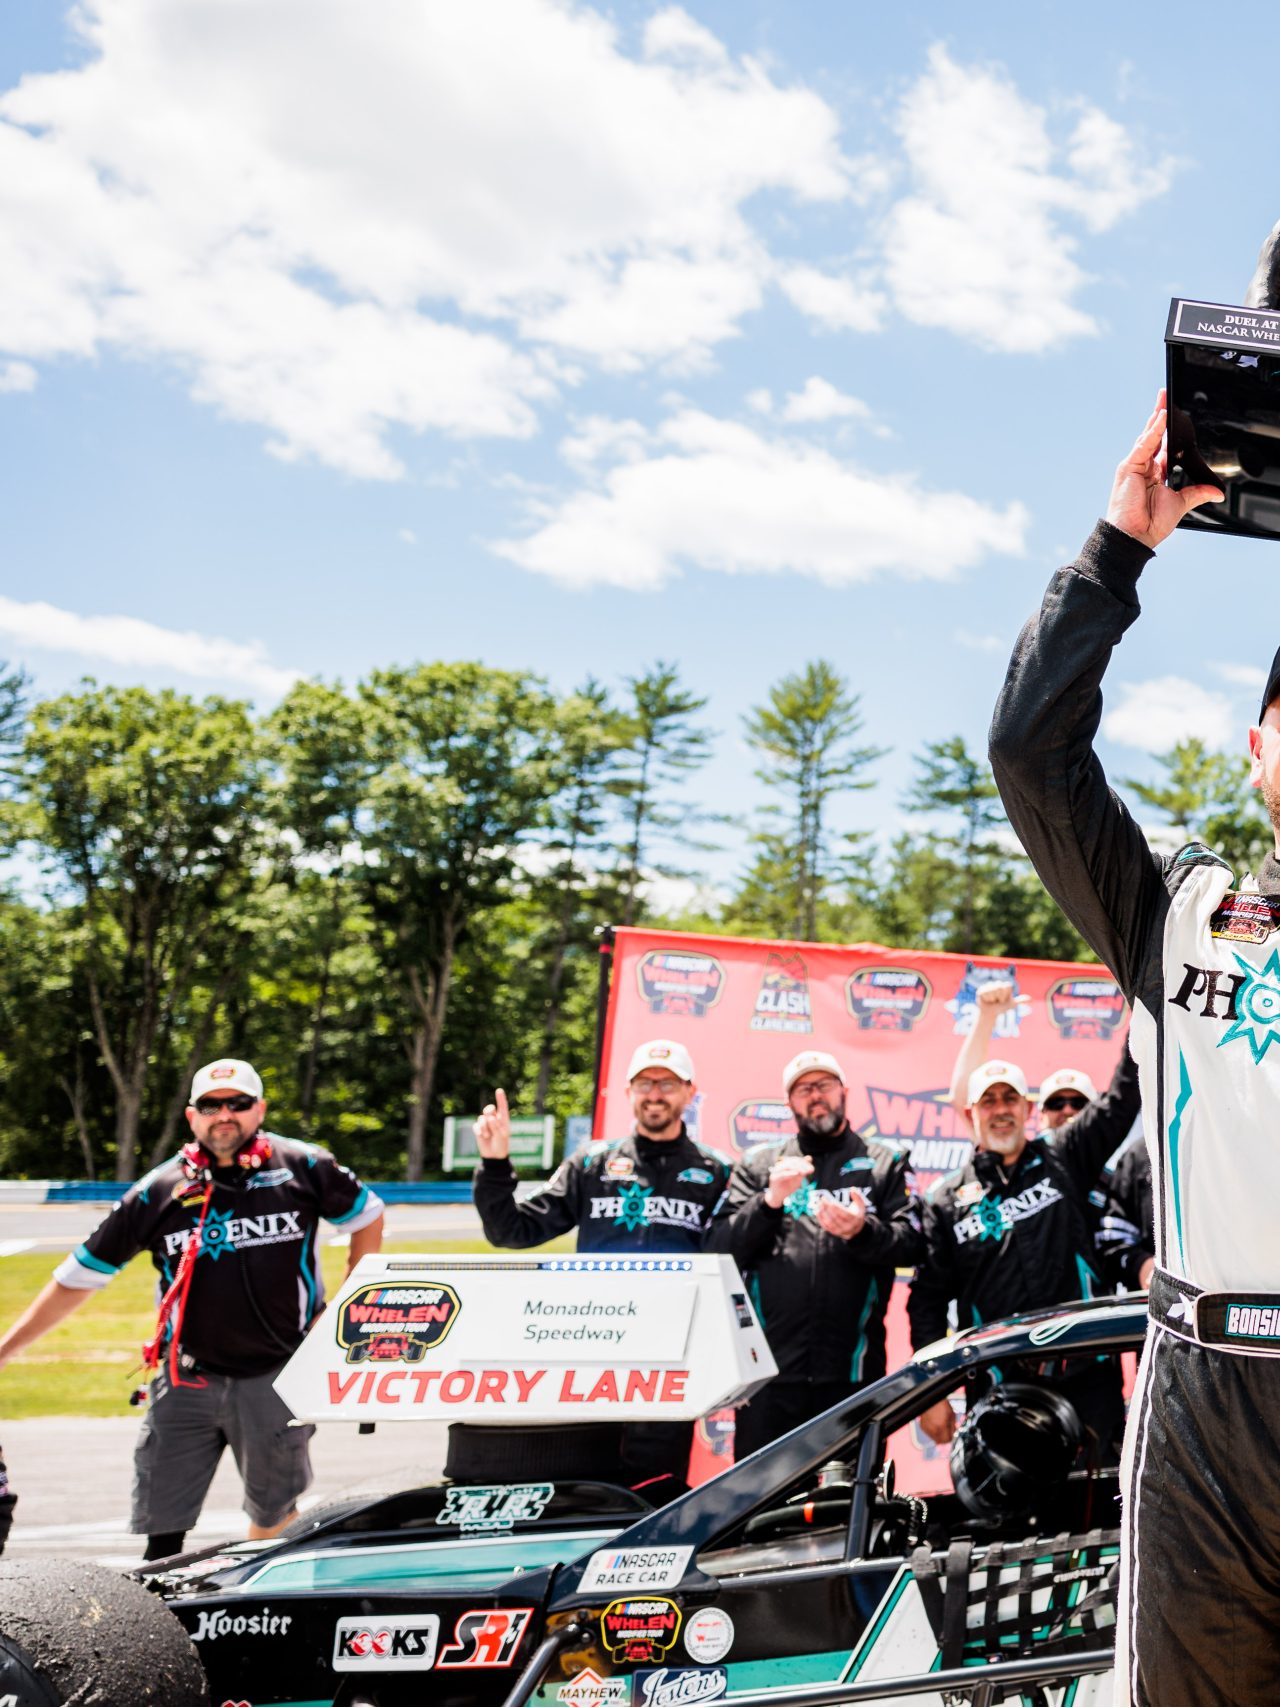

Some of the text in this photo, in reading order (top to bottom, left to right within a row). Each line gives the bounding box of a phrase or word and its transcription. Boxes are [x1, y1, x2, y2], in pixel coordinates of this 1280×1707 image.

[1197, 322, 1249, 338] NASCAR
[1224, 315, 1259, 328] DUEL
[1261, 320, 1279, 330] AT
[1239, 895, 1280, 909] NASCAR
[755, 988, 811, 1016] CLASH
[590, 1196, 705, 1225] PHOENIX
[953, 1177, 1063, 1244] PHOENIX
[381, 1289, 445, 1305] NASCAR
[349, 1302, 451, 1323] WHELEN
[524, 1300, 638, 1318] Monadnock
[524, 1324, 626, 1344] Speedway
[327, 1370, 690, 1404] VICTORY LANE
[619, 1552, 677, 1569] NASCAR
[595, 1571, 669, 1586] RACE CAR
[627, 1602, 669, 1615] NASCAR
[189, 1607, 293, 1641] Hoosier
[606, 1612, 676, 1631] WHELEN
[337, 1627, 430, 1657] KOOKS
[559, 1687, 621, 1699] MAYHEW
